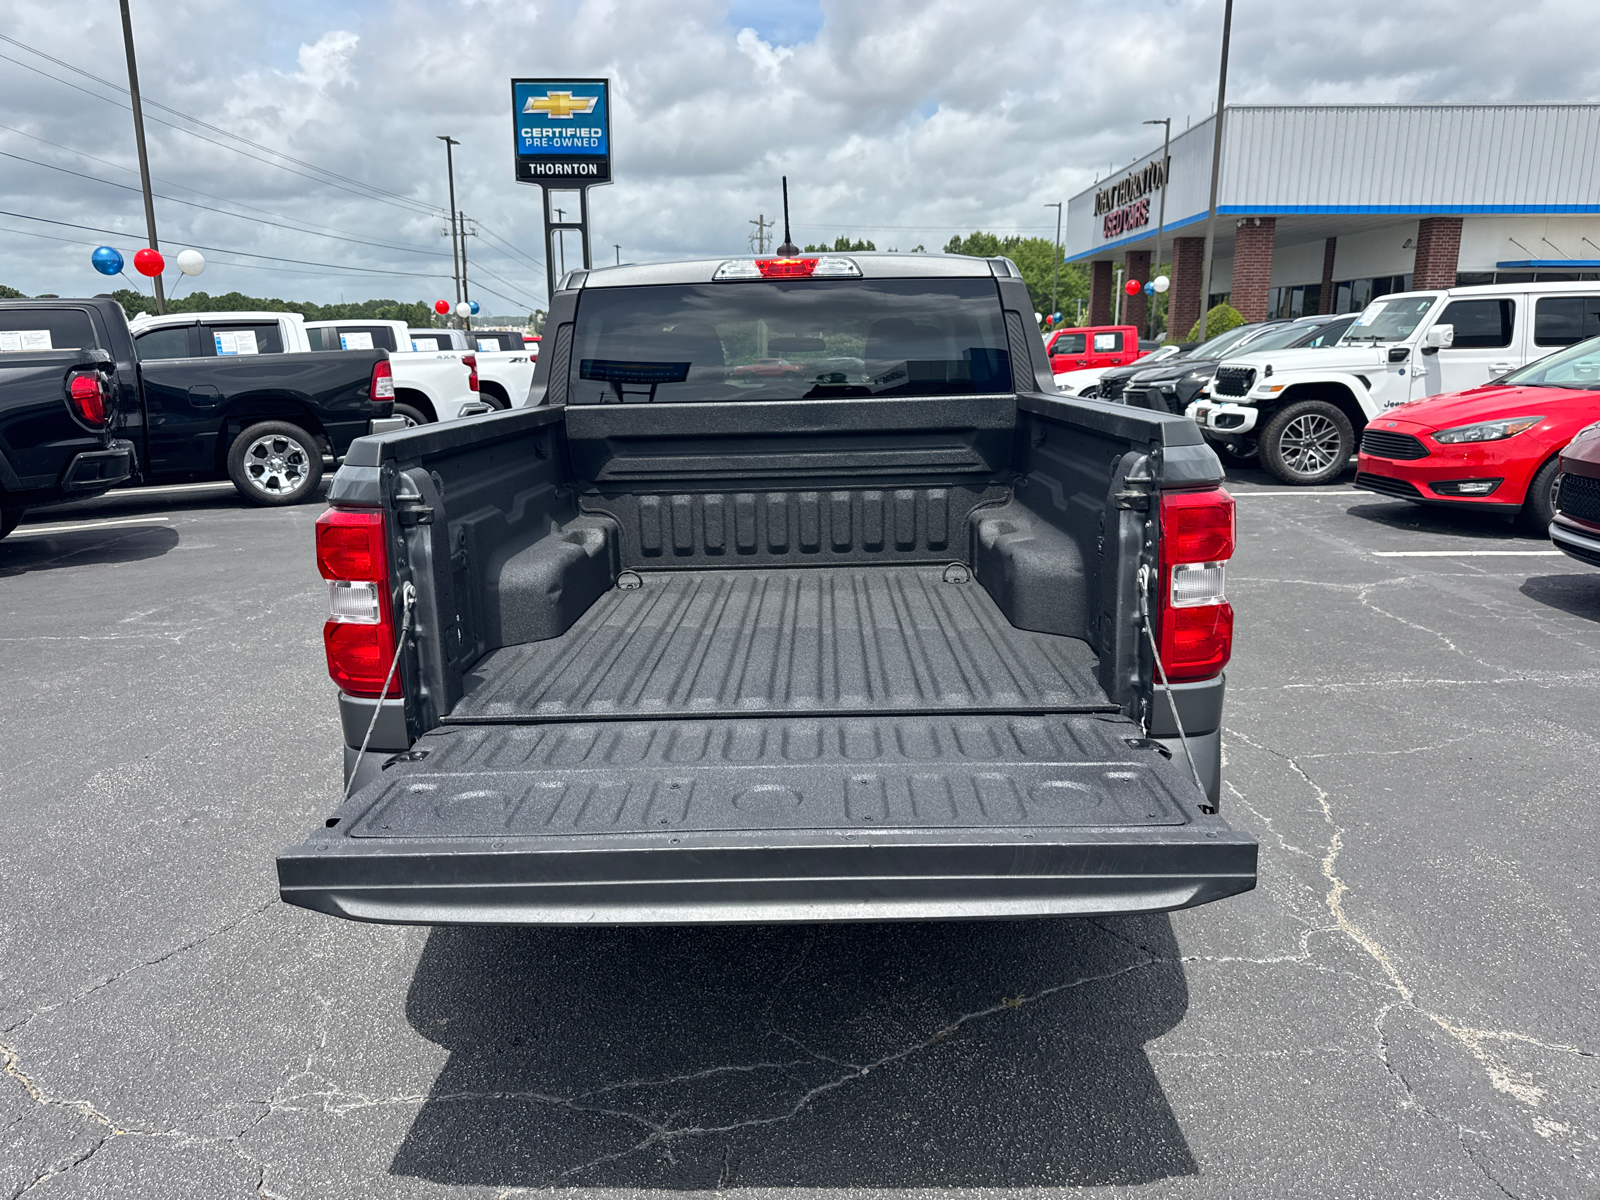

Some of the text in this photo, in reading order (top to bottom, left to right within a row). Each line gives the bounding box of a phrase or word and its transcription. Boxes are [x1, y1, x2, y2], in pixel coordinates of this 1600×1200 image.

[521, 127, 602, 137] CERTIFIED
[525, 138, 599, 147] PRE-OWNED
[528, 163, 598, 175] THORNTON
[1115, 155, 1171, 207] THORNTON
[1103, 198, 1150, 238] USED CARS
[1384, 400, 1405, 408] Jee
